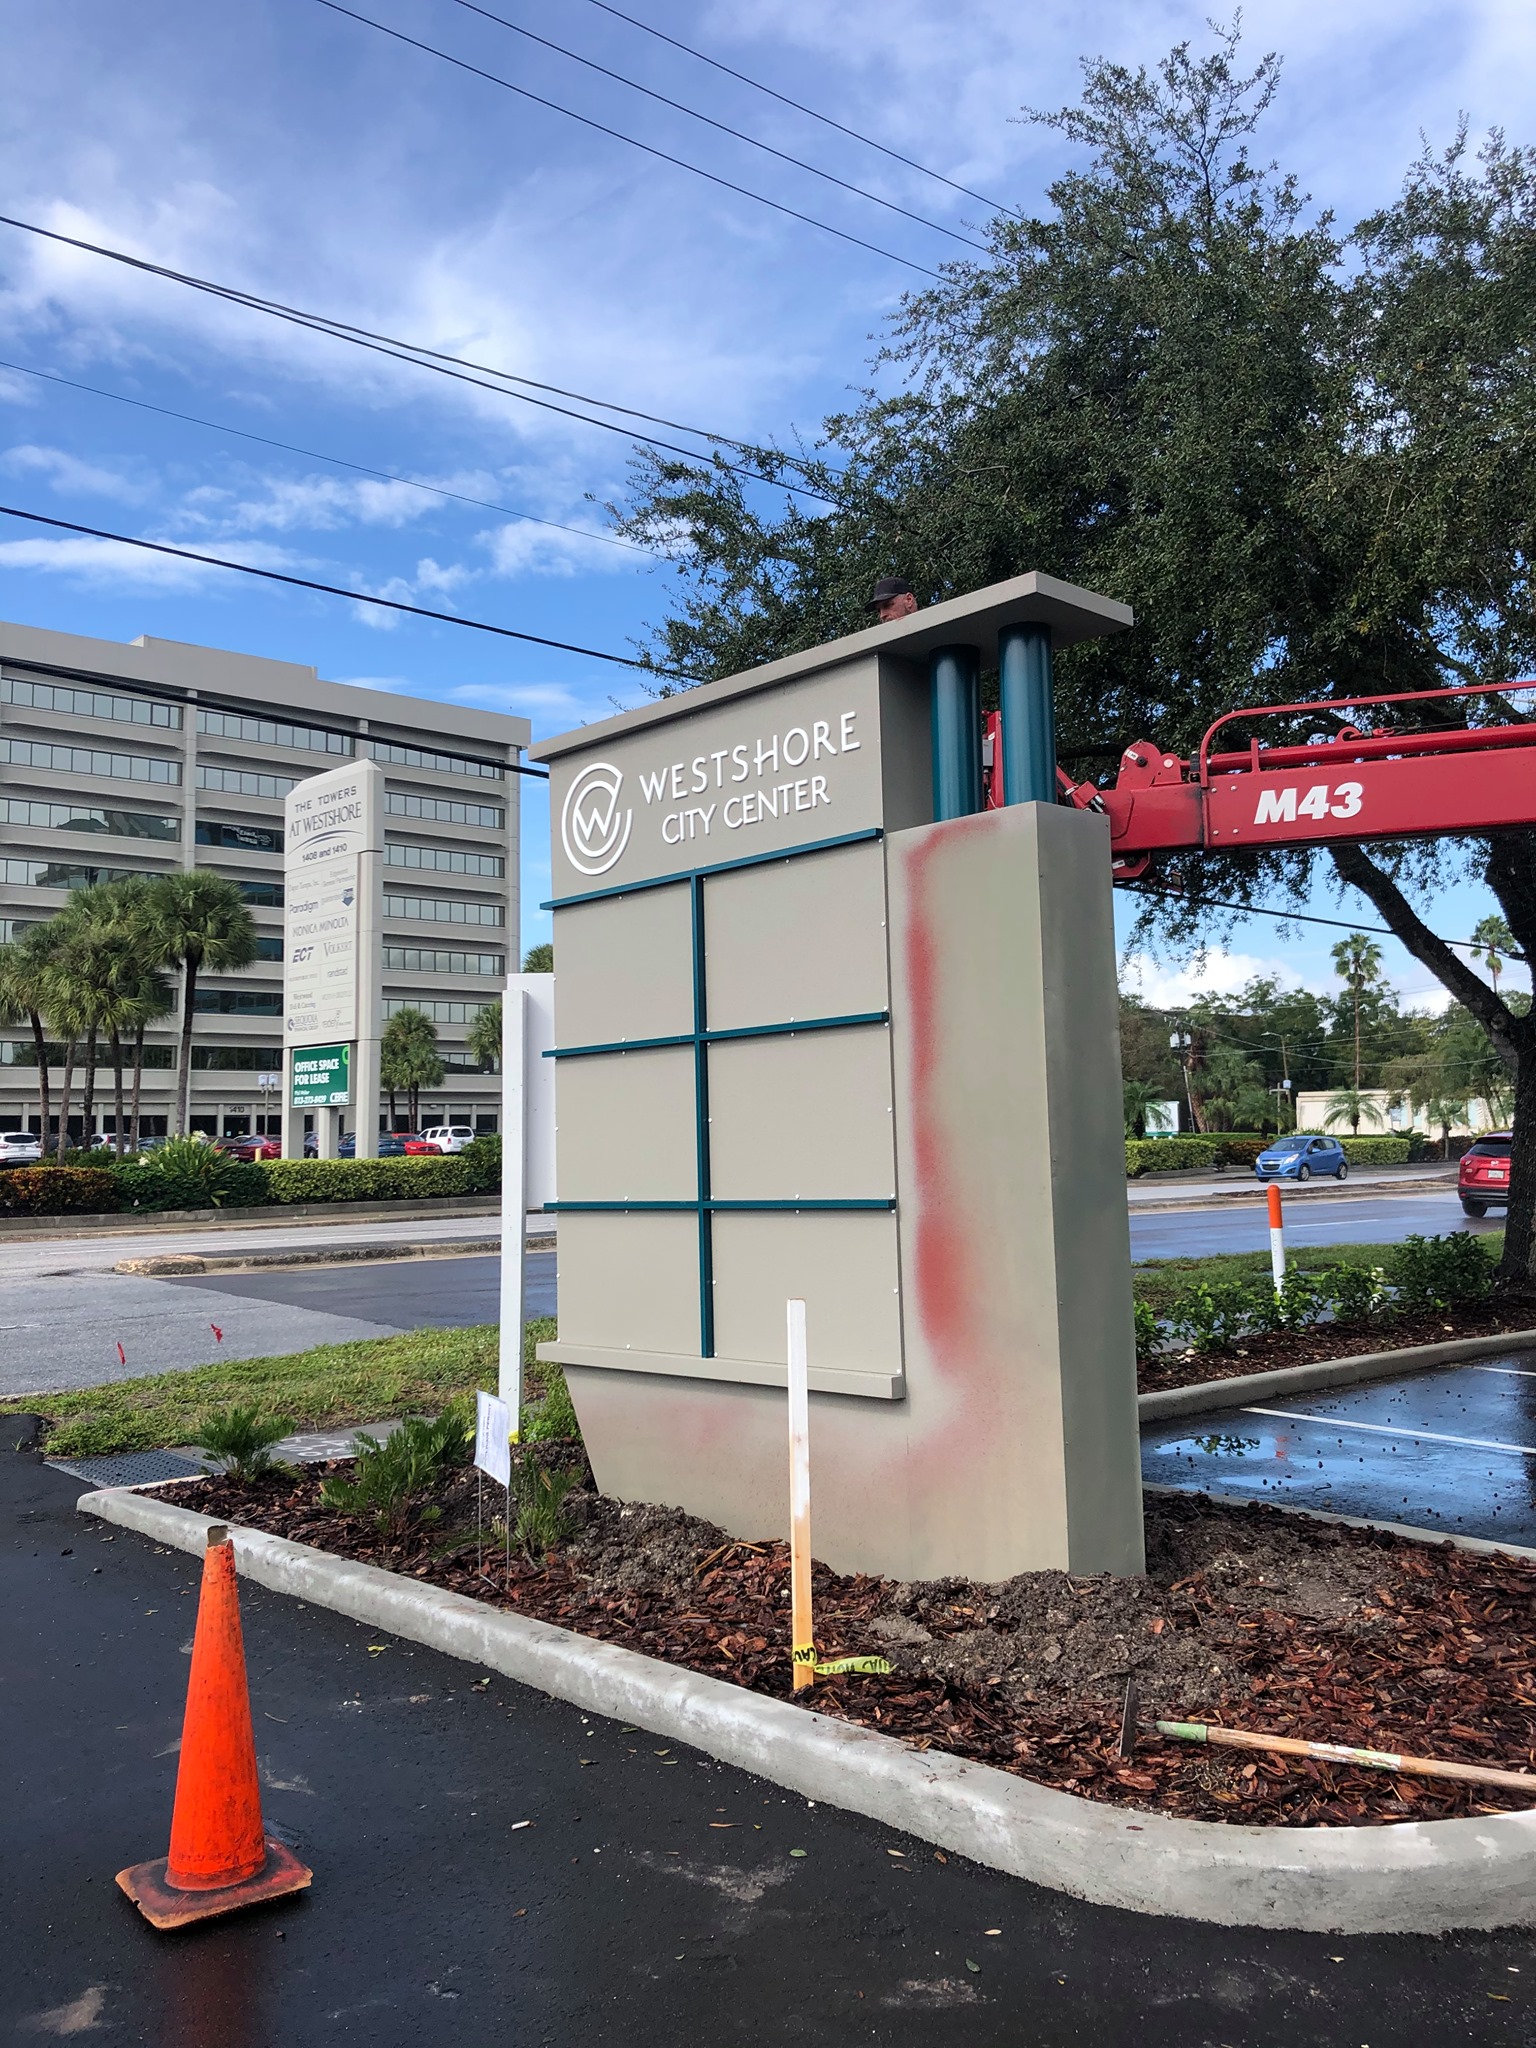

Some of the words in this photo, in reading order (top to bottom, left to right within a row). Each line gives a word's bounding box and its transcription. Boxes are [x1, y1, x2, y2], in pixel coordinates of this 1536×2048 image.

[639, 711, 861, 804] WESTSHORE
[295, 800, 312, 813] THE
[318, 786, 357, 805] TOWERS
[661, 804, 717, 844] CITY
[723, 775, 831, 829] CENTER
[1253, 782, 1364, 825] M43
[289, 820, 301, 838] AT
[303, 802, 362, 833] WESTSHORE
[302, 851, 317, 862] 1408
[319, 847, 331, 858] and
[332, 843, 348, 854] 1410
[289, 900, 319, 914] Paradigm
[292, 923, 318, 938] KONICA
[320, 916, 350, 932] MINOLTA
[293, 946, 314, 963] ECT
[294, 1060, 318, 1073] OFFICE
[318, 1058, 340, 1071] SPACE
[294, 1074, 309, 1086] FOR
[310, 1072, 330, 1085] LEASE
